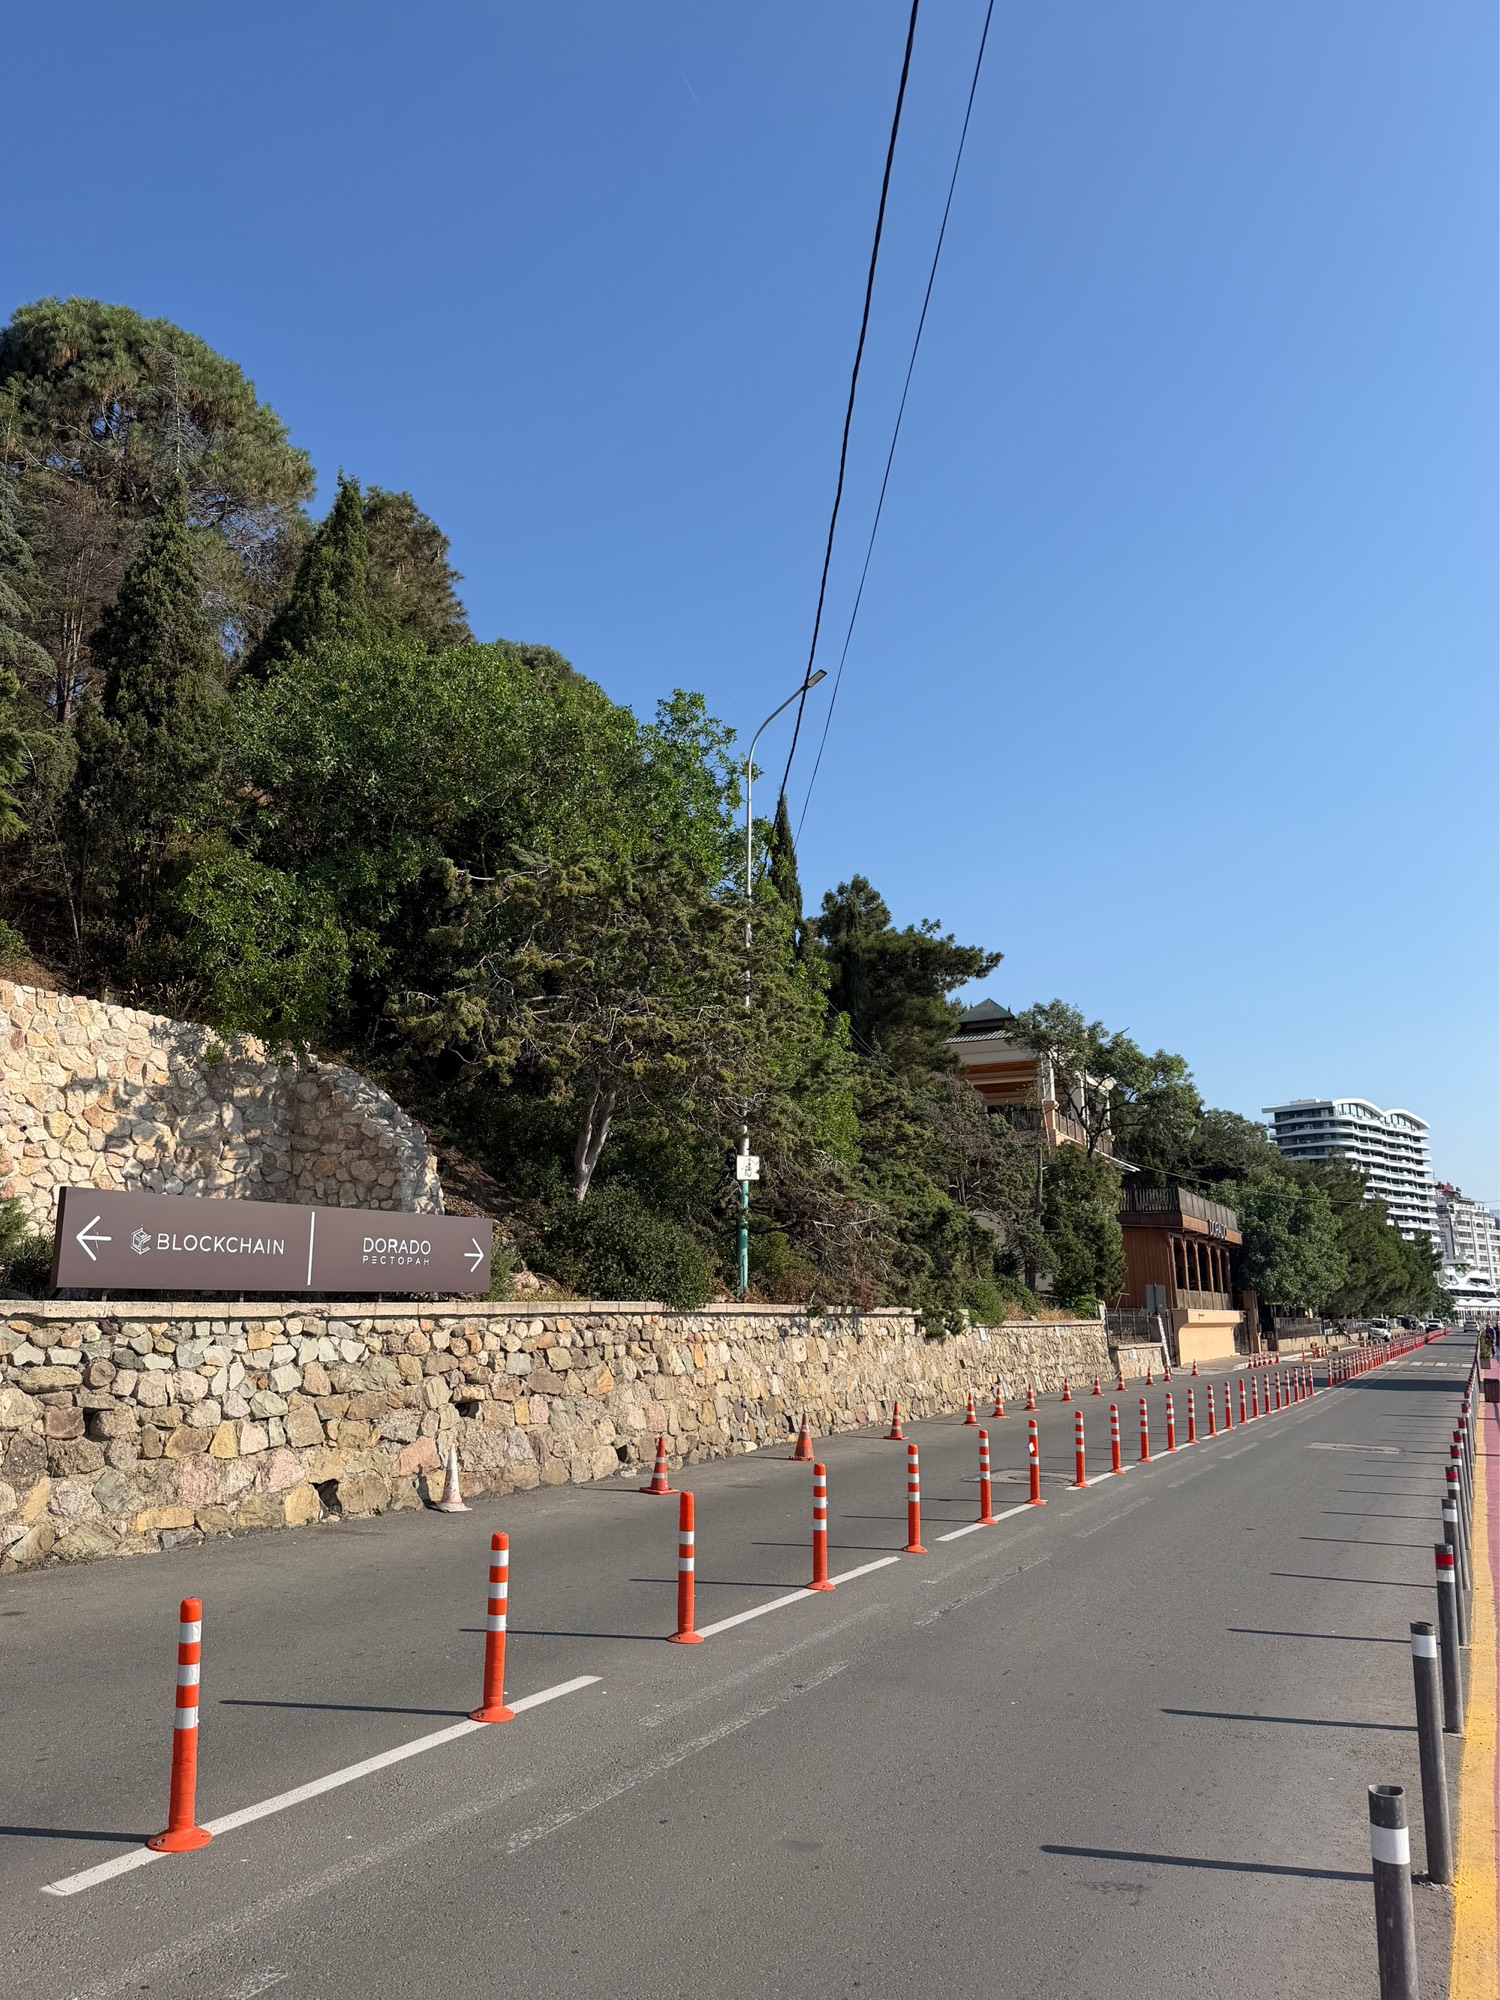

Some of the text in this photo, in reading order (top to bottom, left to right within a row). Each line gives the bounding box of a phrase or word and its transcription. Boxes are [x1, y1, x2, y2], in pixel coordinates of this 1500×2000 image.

[157, 1232, 285, 1255] BLOCKCHAIN
[362, 1237, 431, 1255] DORADO
[362, 1255, 430, 1266] РЕСТОРАН
